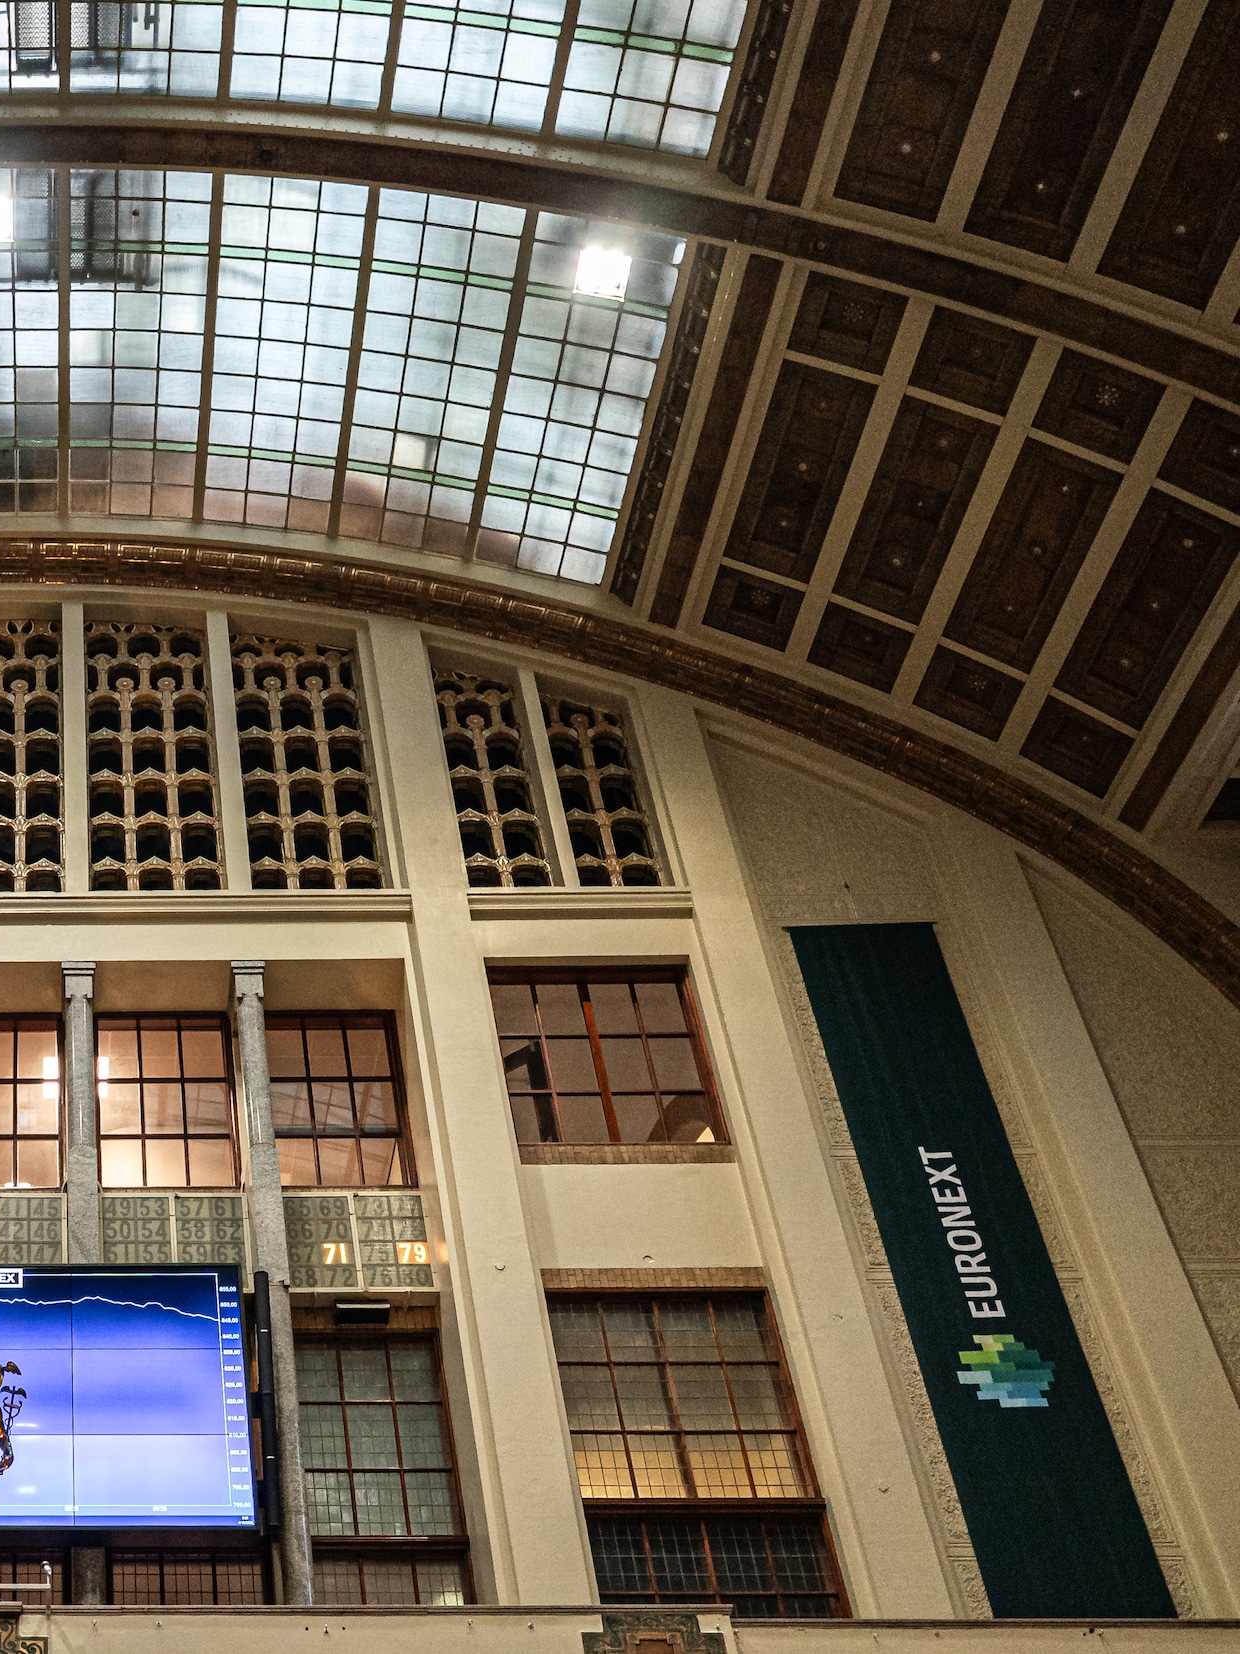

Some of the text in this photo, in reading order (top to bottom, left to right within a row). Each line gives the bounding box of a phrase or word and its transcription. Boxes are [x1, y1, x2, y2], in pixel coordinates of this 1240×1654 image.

[0, 1200, 21, 1217] 41
[32, 1200, 59, 1217] 45
[105, 1199, 237, 1217] 49 53 57 61
[285, 1199, 310, 1217] 65
[319, 1198, 346, 1217] 69
[356, 1198, 385, 1216] 73
[32, 1221, 58, 1241] 46
[104, 1221, 242, 1241] 50 54 58 62
[286, 1222, 313, 1241] 66
[321, 1222, 348, 1241] 70
[917, 1146, 1007, 1318] EURONEXT
[31, 1245, 58, 1264] 47
[105, 1244, 243, 1263] 51 55 59 63
[289, 1246, 316, 1264] 67
[322, 1243, 348, 1264] 71
[398, 1243, 427, 1264] 79
[291, 1267, 429, 1288] 68 72 76 80
